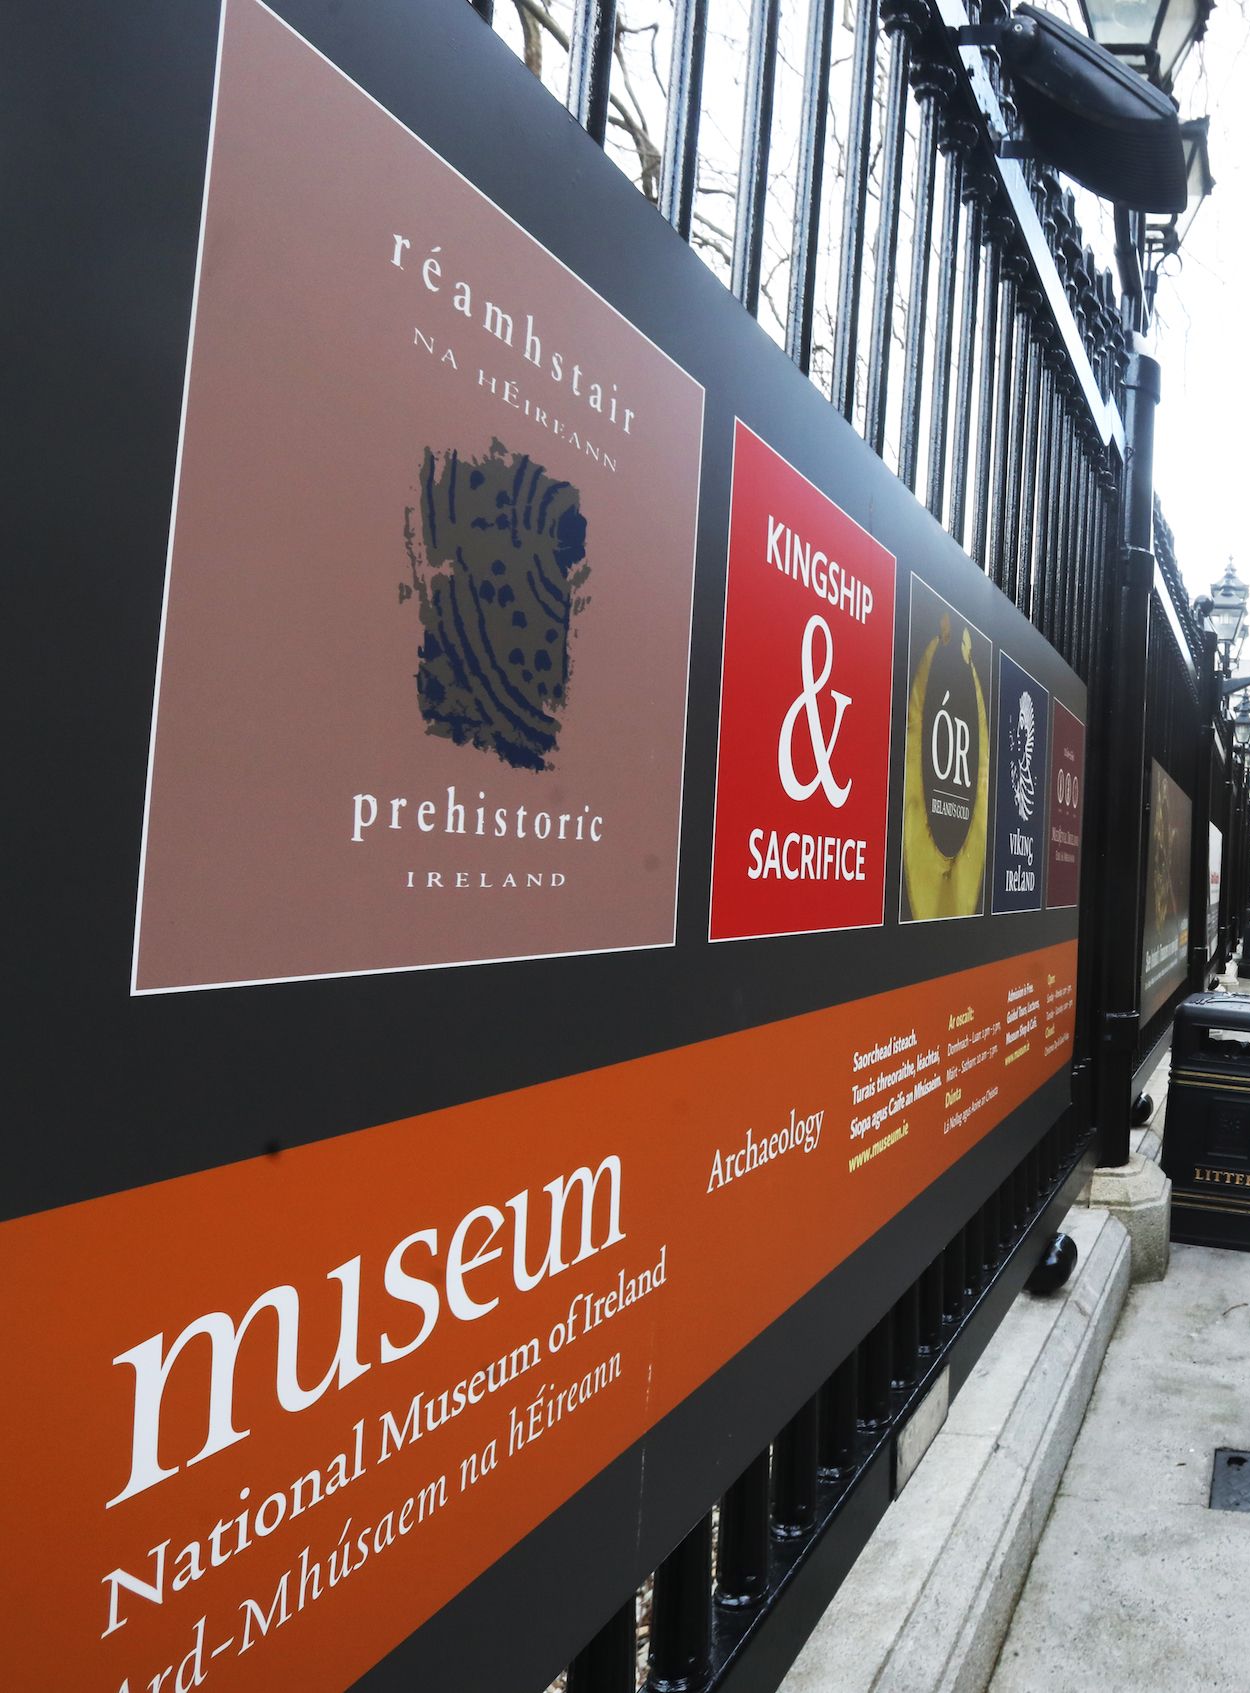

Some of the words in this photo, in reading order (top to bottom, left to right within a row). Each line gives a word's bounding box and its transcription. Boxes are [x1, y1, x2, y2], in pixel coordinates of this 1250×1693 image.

[390, 233, 635, 435] réamhstair
[413, 327, 458, 370] NA
[477, 368, 617, 473] HÉIREANN
[766, 514, 873, 624] KINGSHIP
[778, 614, 852, 808] &
[931, 690, 971, 788] ÓR
[350, 785, 603, 841] prehistoric
[956, 804, 970, 821] GOLD
[406, 871, 566, 888] IRELAND
[747, 828, 866, 882] SACRIFICE
[853, 1036, 892, 1072] Saorchead
[892, 1028, 917, 1055] isteach.
[948, 1013, 956, 1031] Ar
[850, 1115, 871, 1140] Siopa
[871, 1105, 888, 1130] agus
[888, 1090, 905, 1116] Caife
[905, 1090, 914, 1106] an
[852, 1077, 875, 1105] Turais
[877, 1060, 916, 1093] threoraithe,
[706, 1108, 825, 1194] Archaeology
[848, 1119, 909, 1173] www.museum.ie
[105, 1153, 627, 1509] museum
[101, 1418, 367, 1640] National
[377, 1337, 542, 1465] Museum
[548, 1293, 584, 1354] of
[582, 1244, 668, 1335] Ireland
[115, 1474, 449, 1693] rd-Mhúsaem
[459, 1438, 499, 1492] na
[508, 1351, 622, 1457] hÉireann
